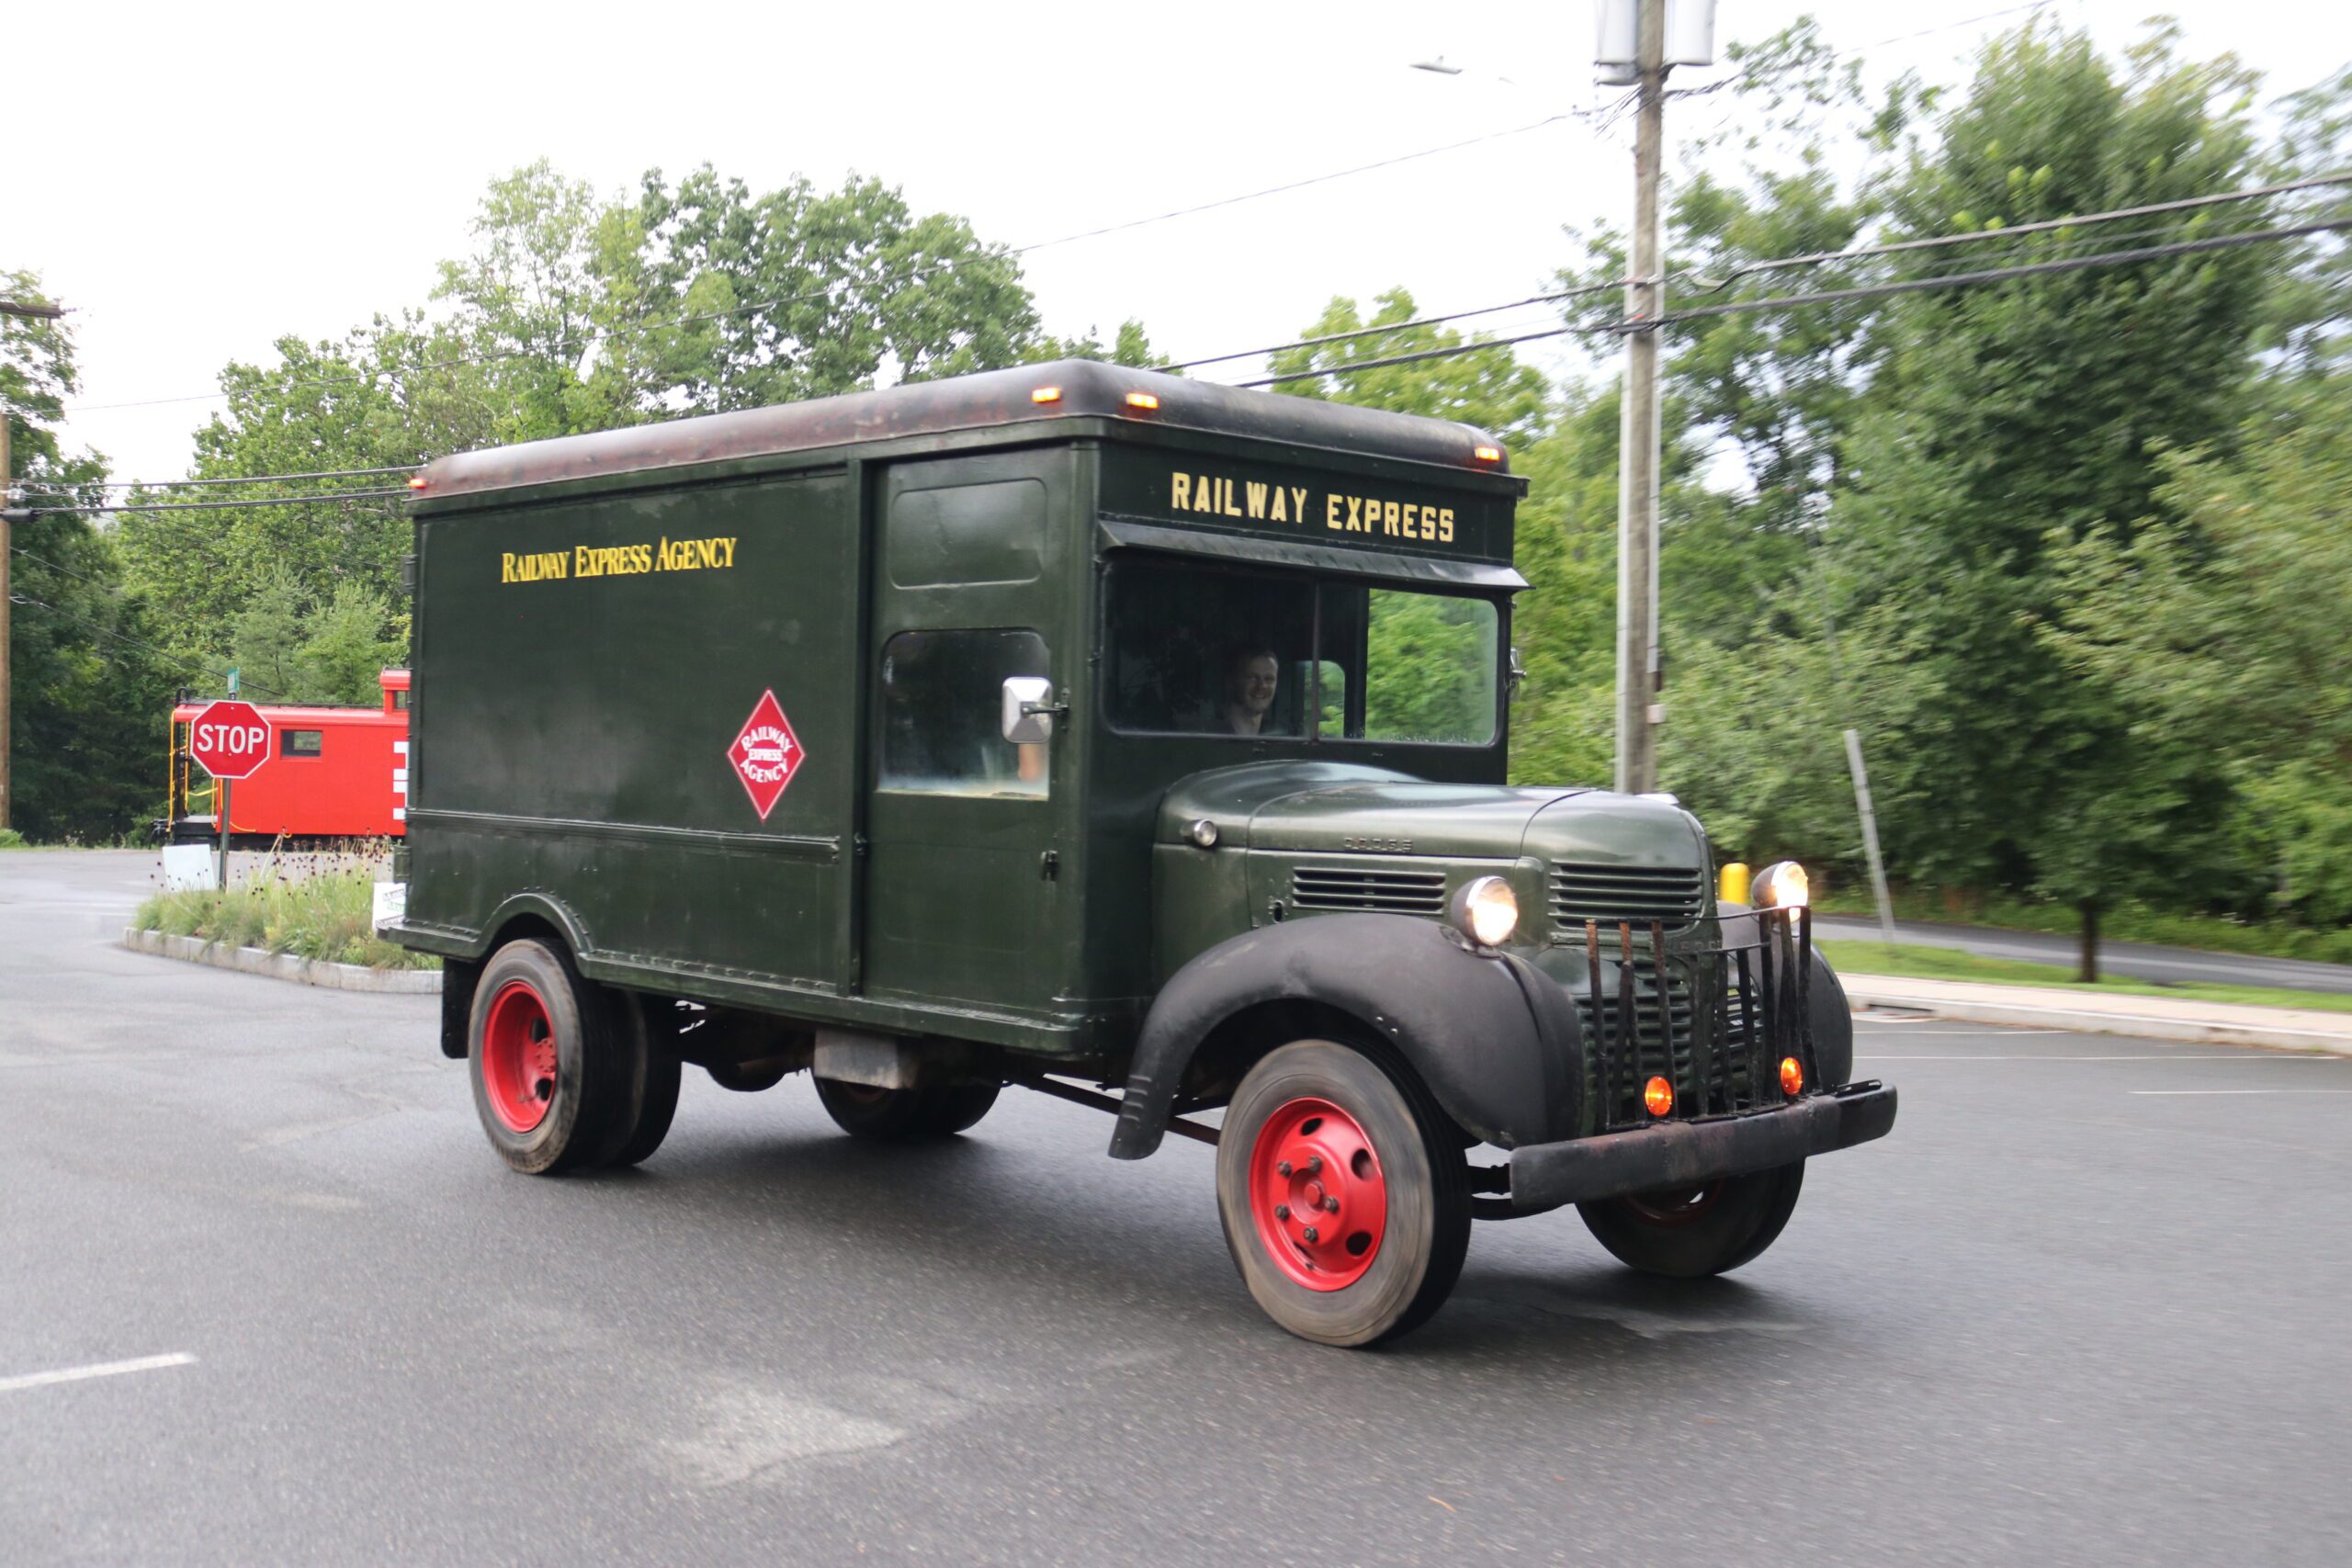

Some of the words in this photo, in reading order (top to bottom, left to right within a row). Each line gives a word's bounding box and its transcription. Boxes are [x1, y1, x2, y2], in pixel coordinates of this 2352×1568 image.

[1171, 471, 1307, 524] RAILWAY
[1327, 493, 1454, 542] EXPRESS
[502, 551, 571, 583] RAILWAY
[574, 545, 652, 578] EXPRESS
[654, 536, 737, 571] AGENCY
[197, 724, 265, 754] STOP
[741, 726, 794, 753] RAILWAY
[740, 758, 788, 783] AGENCY
